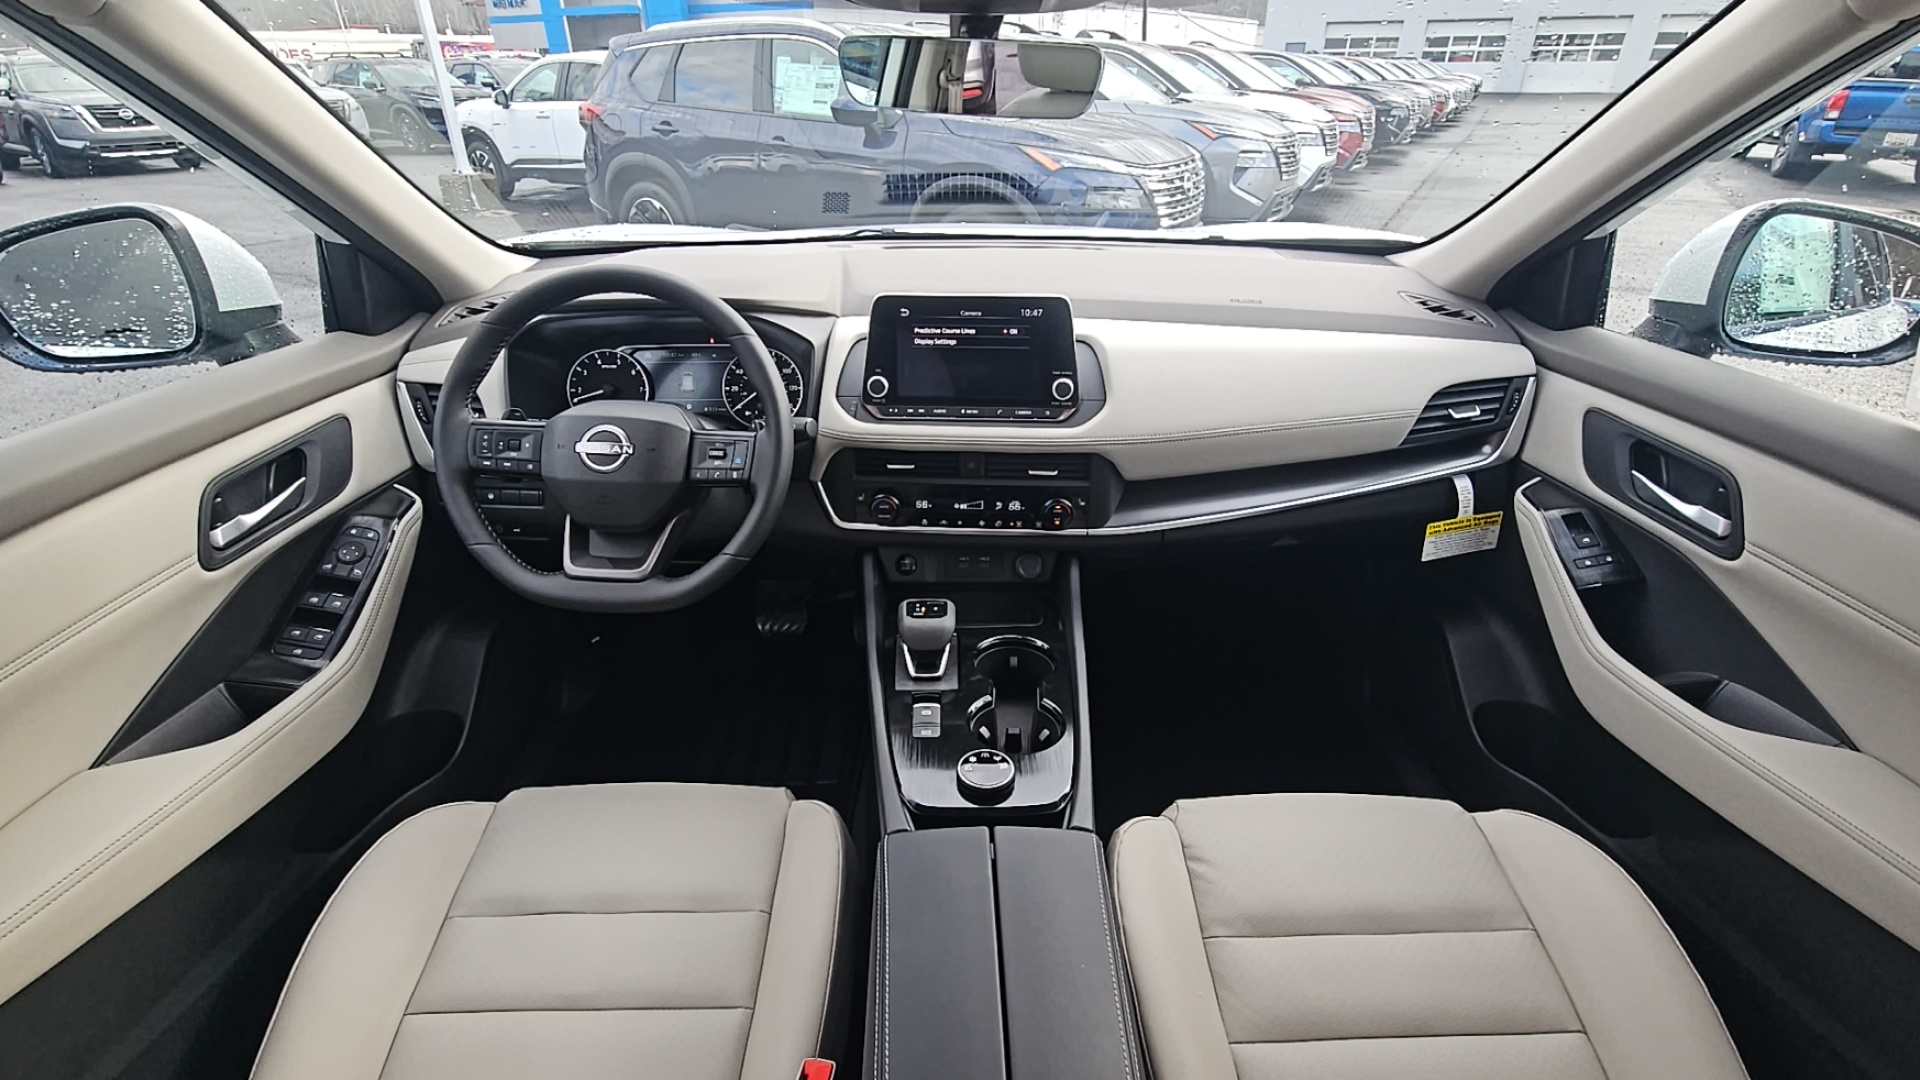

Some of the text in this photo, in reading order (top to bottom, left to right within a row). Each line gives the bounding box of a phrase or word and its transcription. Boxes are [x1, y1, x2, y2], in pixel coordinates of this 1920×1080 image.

[1020, 308, 1044, 317] 10:47
[576, 443, 633, 454] NISSAN
[1443, 519, 1465, 527] Vehicle
[1473, 513, 1501, 521] Equipped
[1443, 523, 1472, 532] Advanced
